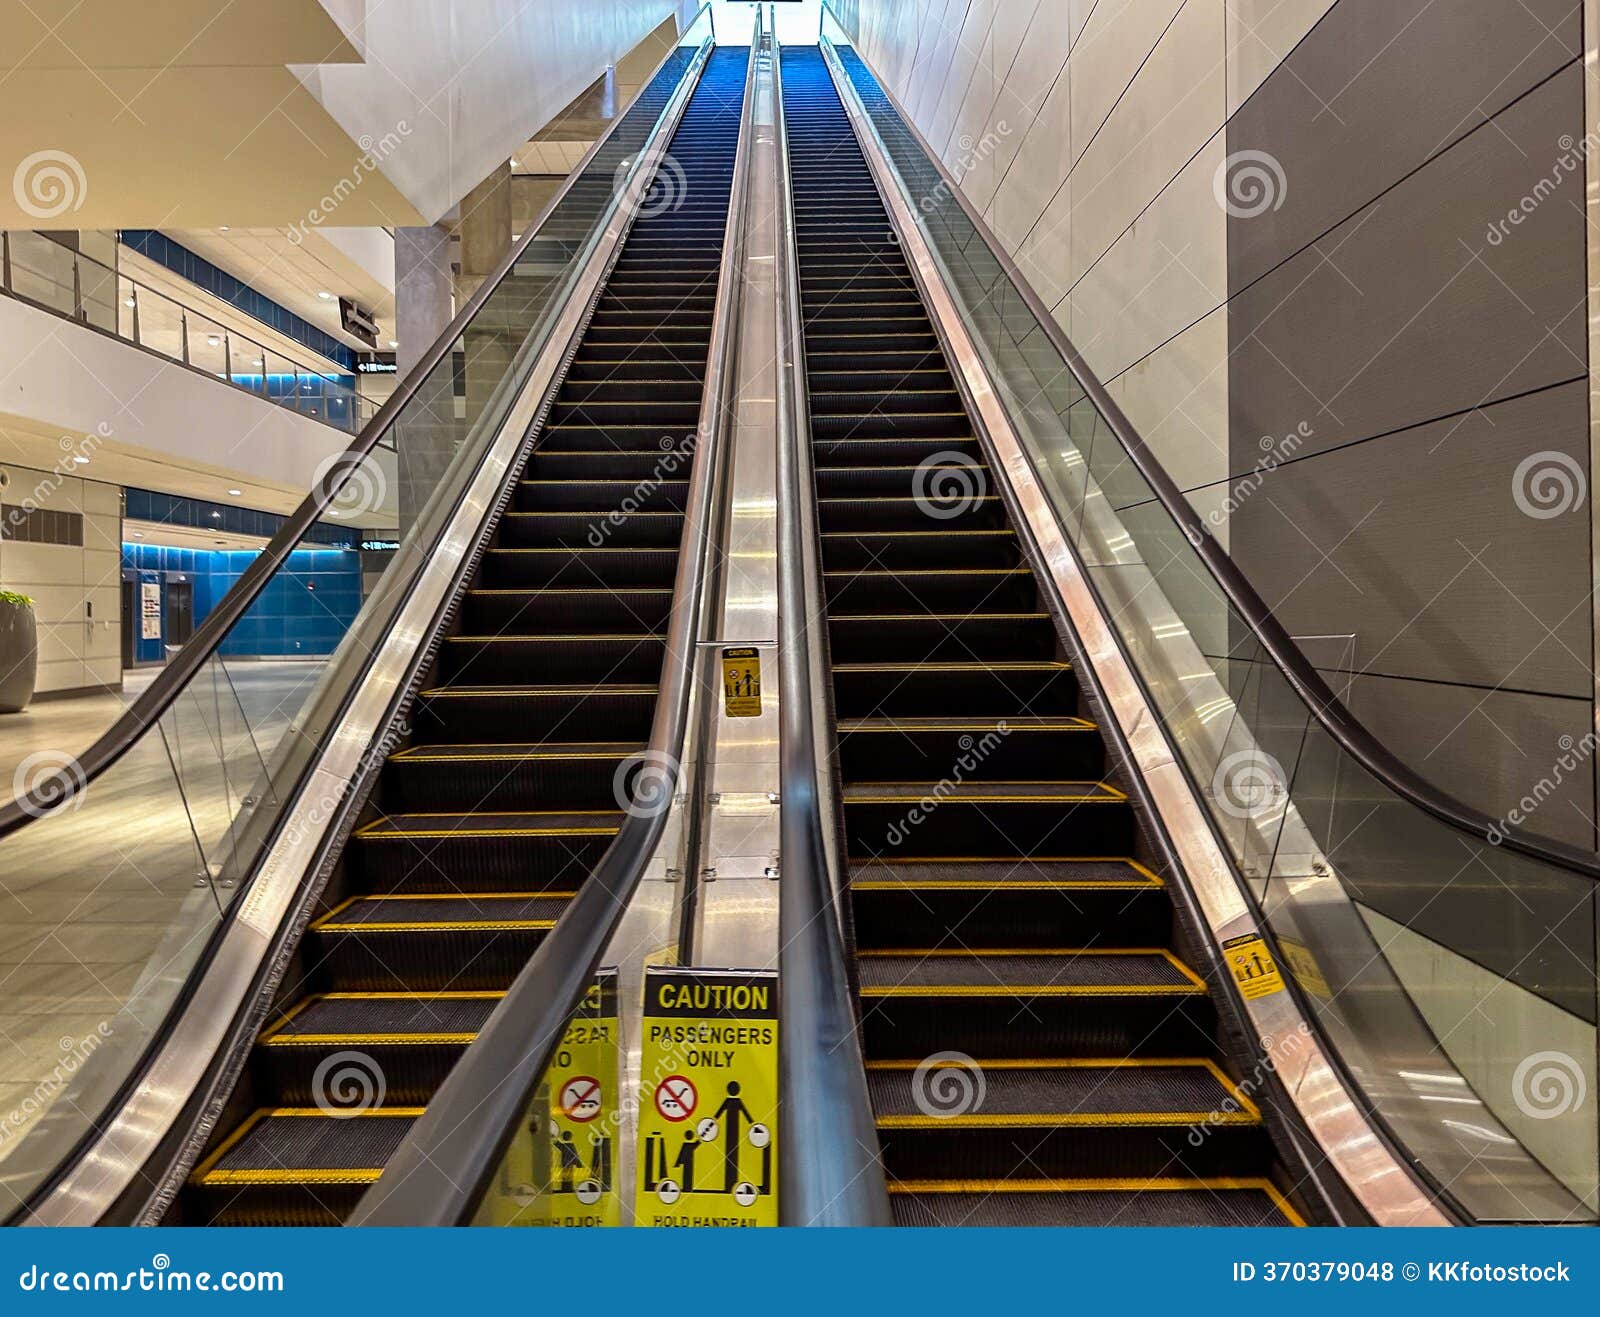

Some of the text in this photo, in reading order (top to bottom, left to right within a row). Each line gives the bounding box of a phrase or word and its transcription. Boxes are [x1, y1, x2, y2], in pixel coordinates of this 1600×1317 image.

[659, 984, 769, 1010] CAUTION
[651, 1026, 772, 1045] PASSENGERS
[687, 1051, 735, 1068] ONLY
[653, 1216, 690, 1227] HOLD
